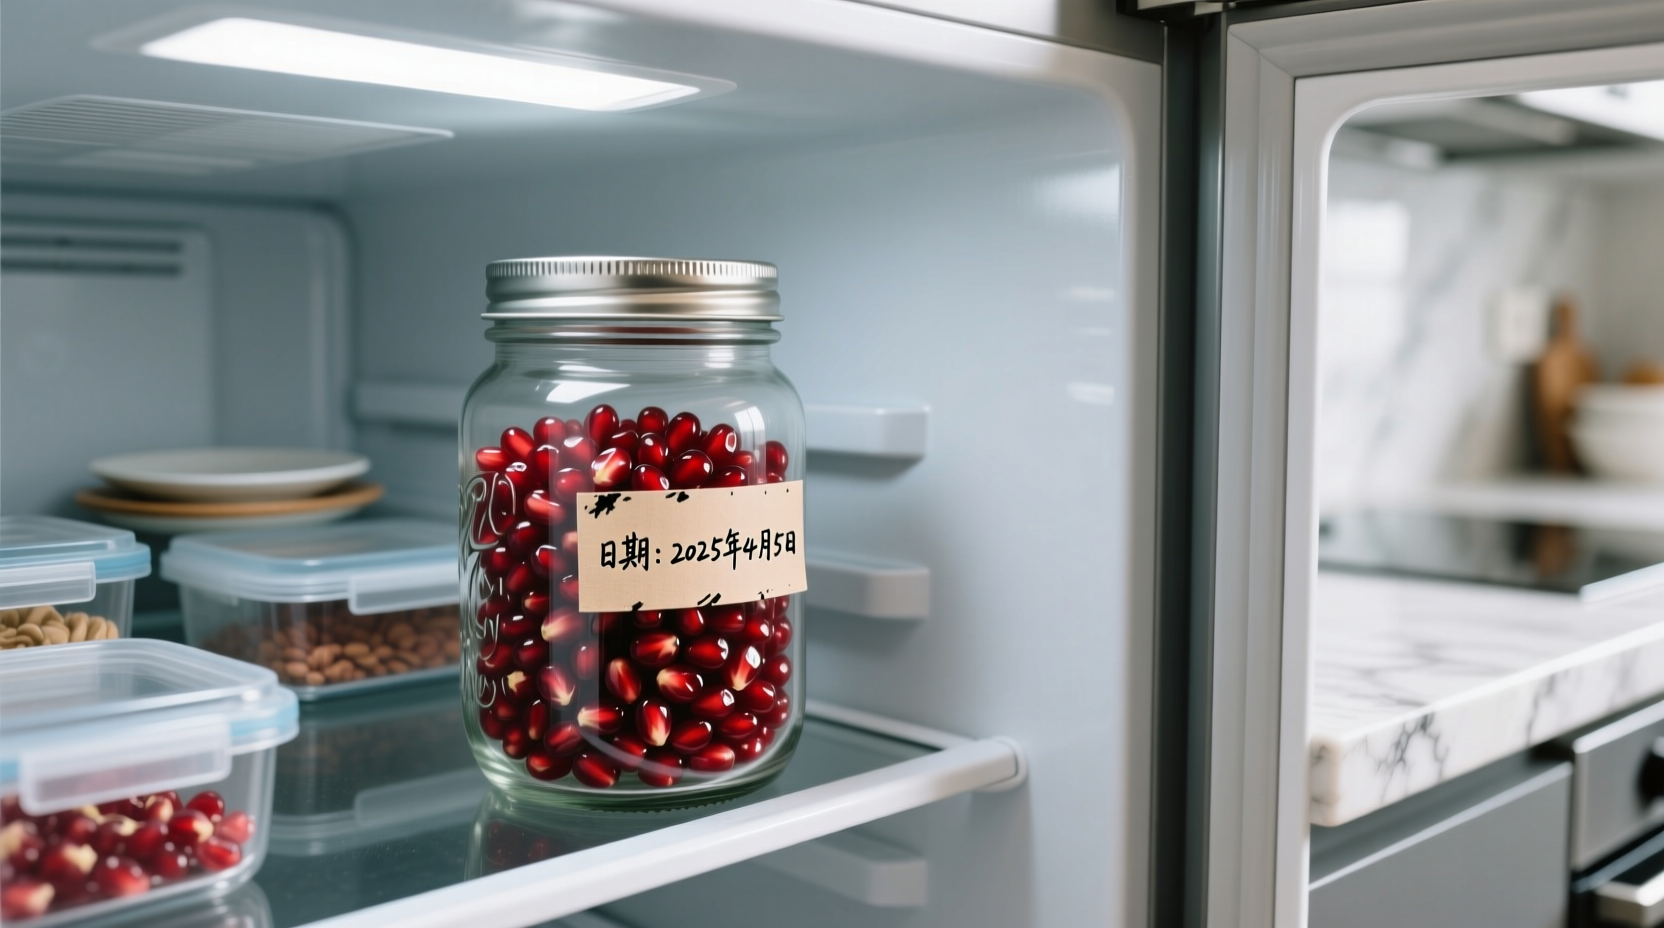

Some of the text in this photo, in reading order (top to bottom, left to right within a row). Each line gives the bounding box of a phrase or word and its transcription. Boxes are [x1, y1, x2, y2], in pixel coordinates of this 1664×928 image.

[600, 528, 796, 571] 日期：2025年4月5日
